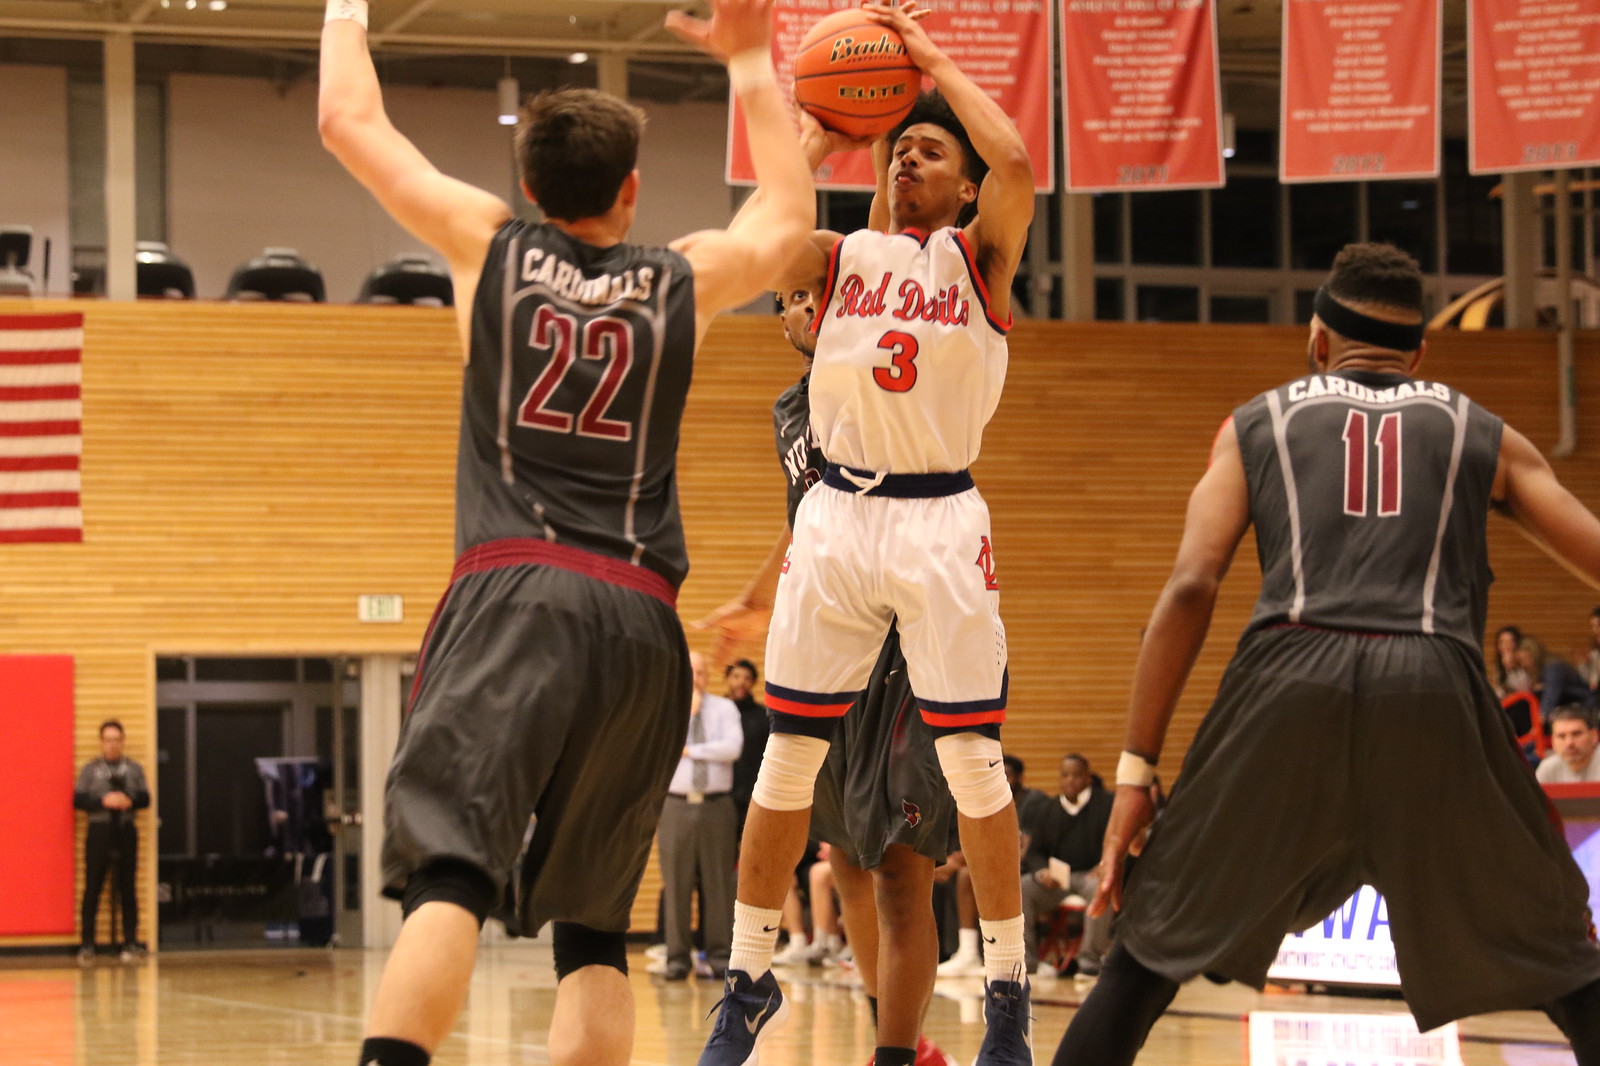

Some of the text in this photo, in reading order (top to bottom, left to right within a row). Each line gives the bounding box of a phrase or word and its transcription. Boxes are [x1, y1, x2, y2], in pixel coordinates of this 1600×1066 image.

[830, 33, 908, 64] Baden
[839, 83, 907, 99] ELITE
[521, 248, 655, 306] CARDINALS
[836, 272, 892, 318] Red
[516, 303, 634, 442] 22
[872, 330, 919, 393] 3
[1288, 374, 1451, 404] CARDINALS
[1341, 408, 1402, 518] 11
